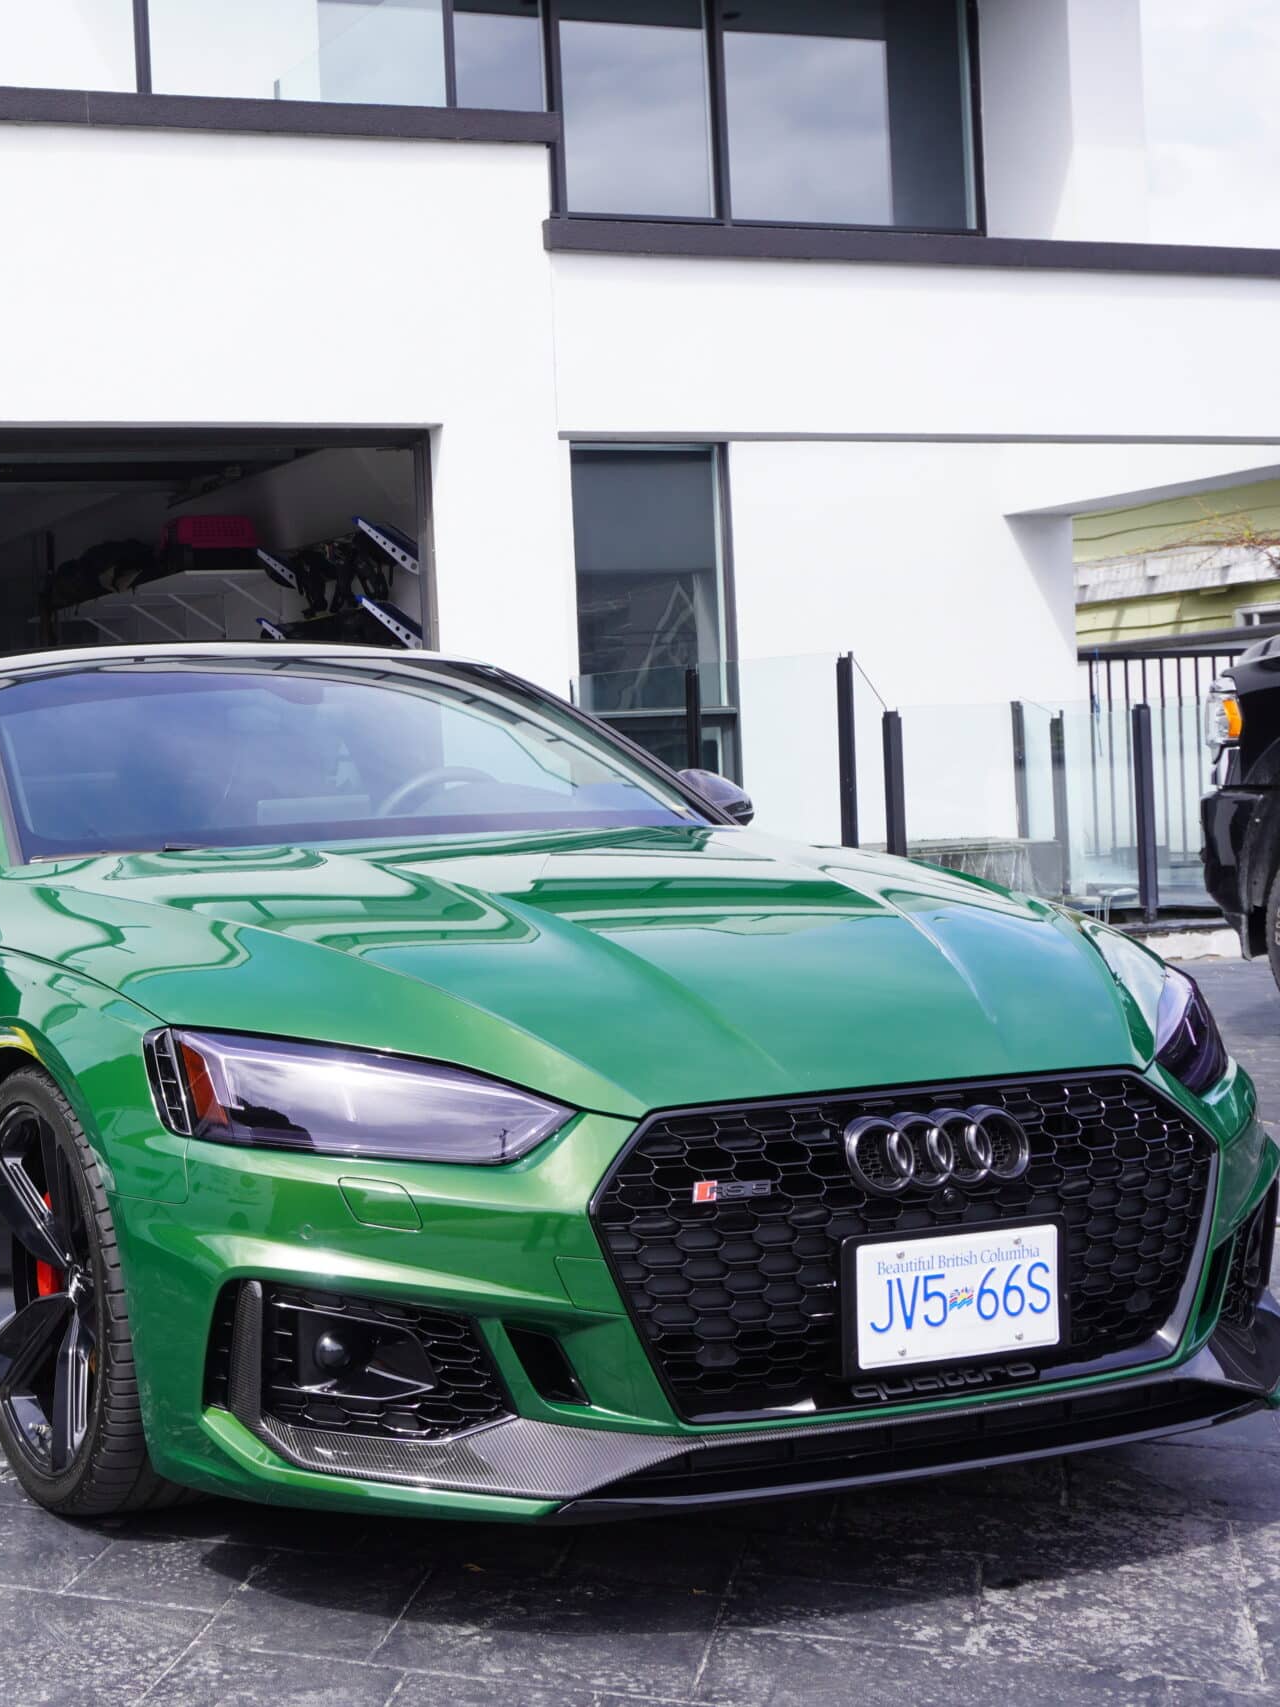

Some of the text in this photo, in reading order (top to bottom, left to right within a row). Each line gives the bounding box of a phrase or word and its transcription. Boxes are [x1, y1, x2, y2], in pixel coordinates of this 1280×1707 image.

[877, 1244, 1040, 1276] Beautiful British Columbia
[870, 1261, 1051, 1333] JV5 66S
[851, 1362, 1037, 1401] quattro
